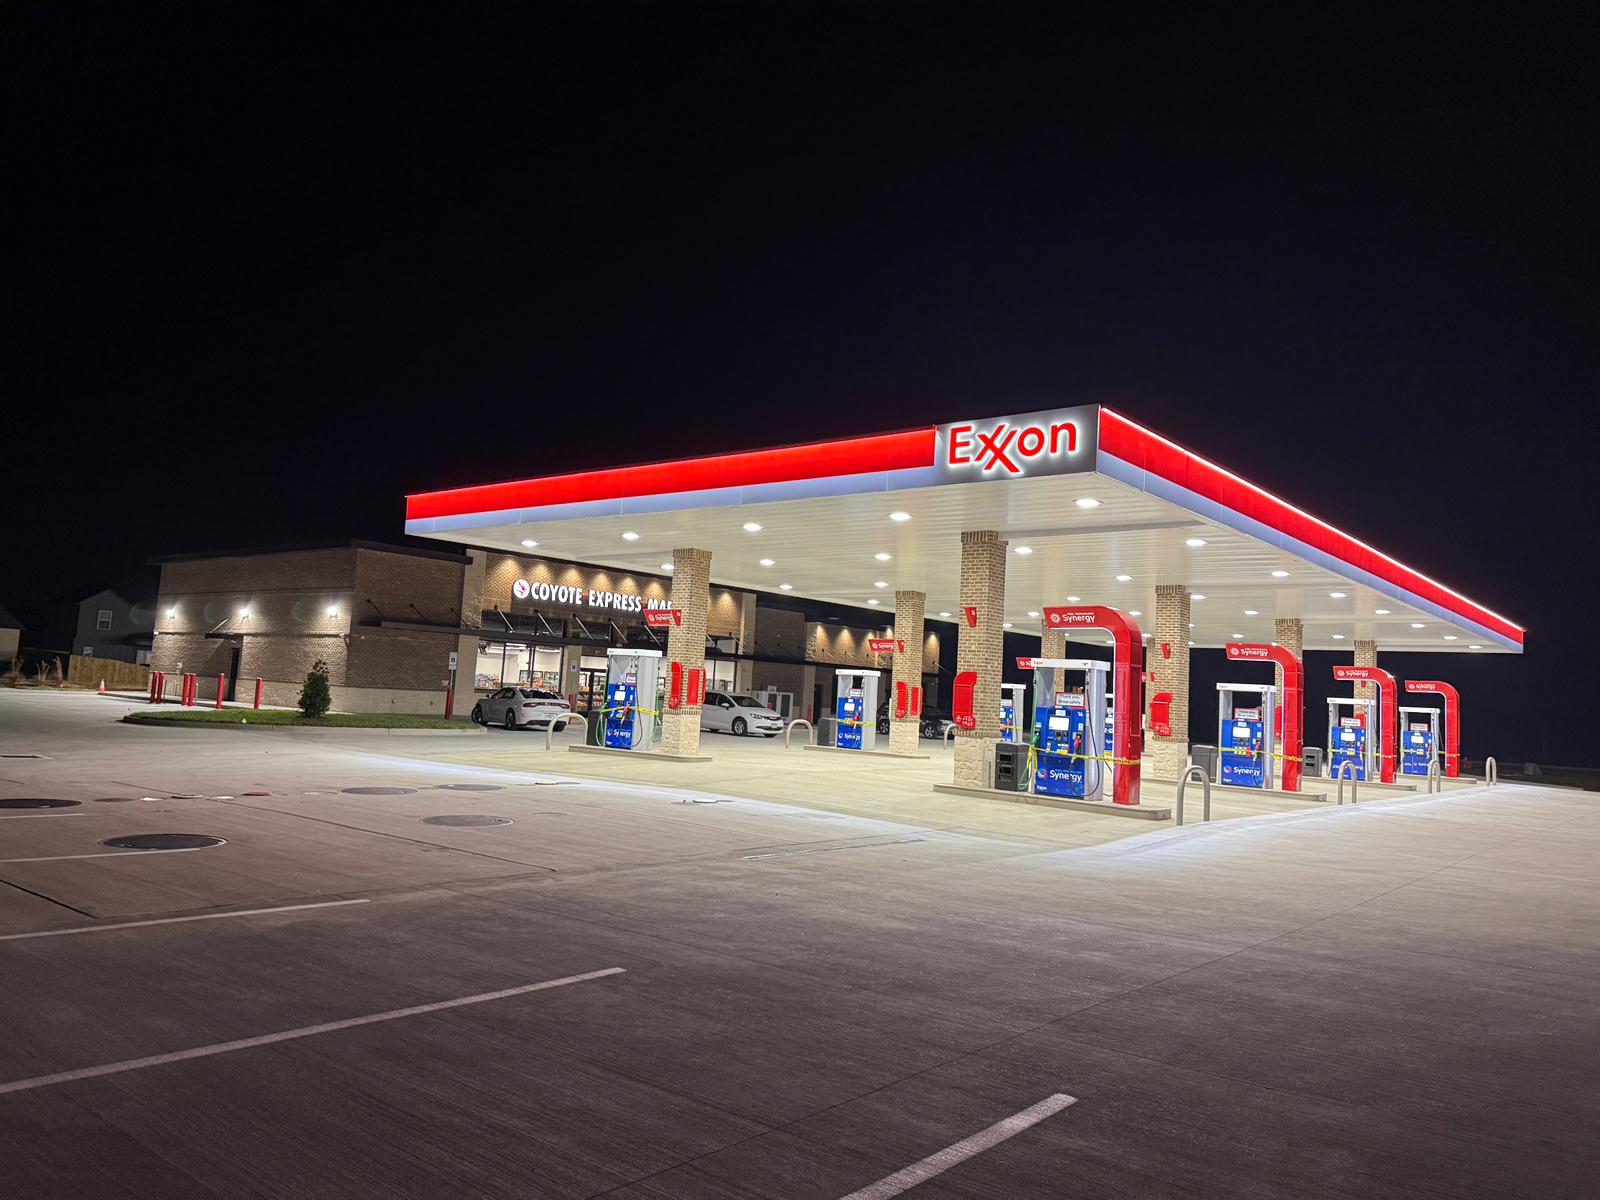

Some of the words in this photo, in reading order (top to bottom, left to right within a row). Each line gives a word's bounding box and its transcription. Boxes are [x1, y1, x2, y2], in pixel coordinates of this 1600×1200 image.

[948, 421, 1077, 474] Exxon
[530, 582, 583, 605] COYOTE
[588, 589, 642, 612] EXPRESS
[1062, 613, 1095, 623] Synergy
[1240, 648, 1269, 657] Synergy
